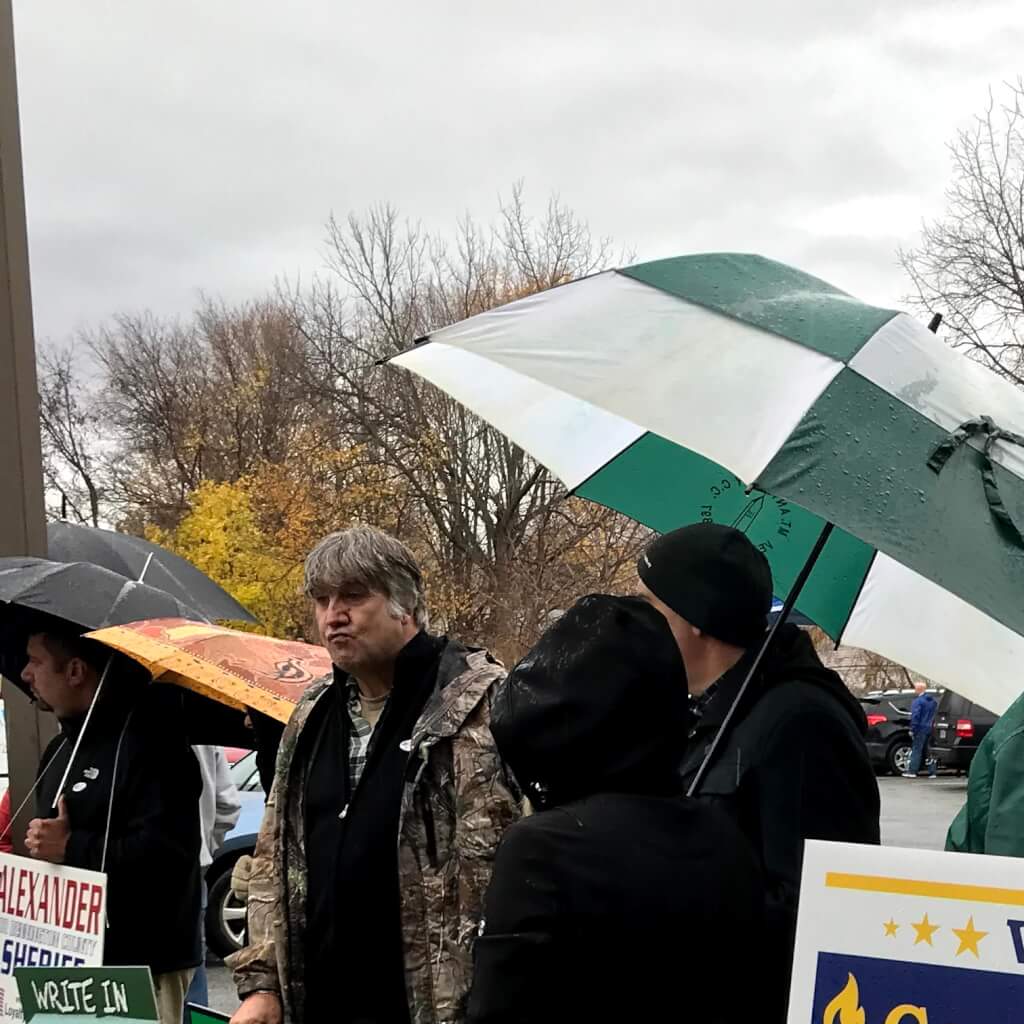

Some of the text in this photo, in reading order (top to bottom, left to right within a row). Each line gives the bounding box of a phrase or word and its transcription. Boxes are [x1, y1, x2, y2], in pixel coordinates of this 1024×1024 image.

[1, 939, 86, 975] SHER
[31, 977, 129, 1014] WRITE IN
